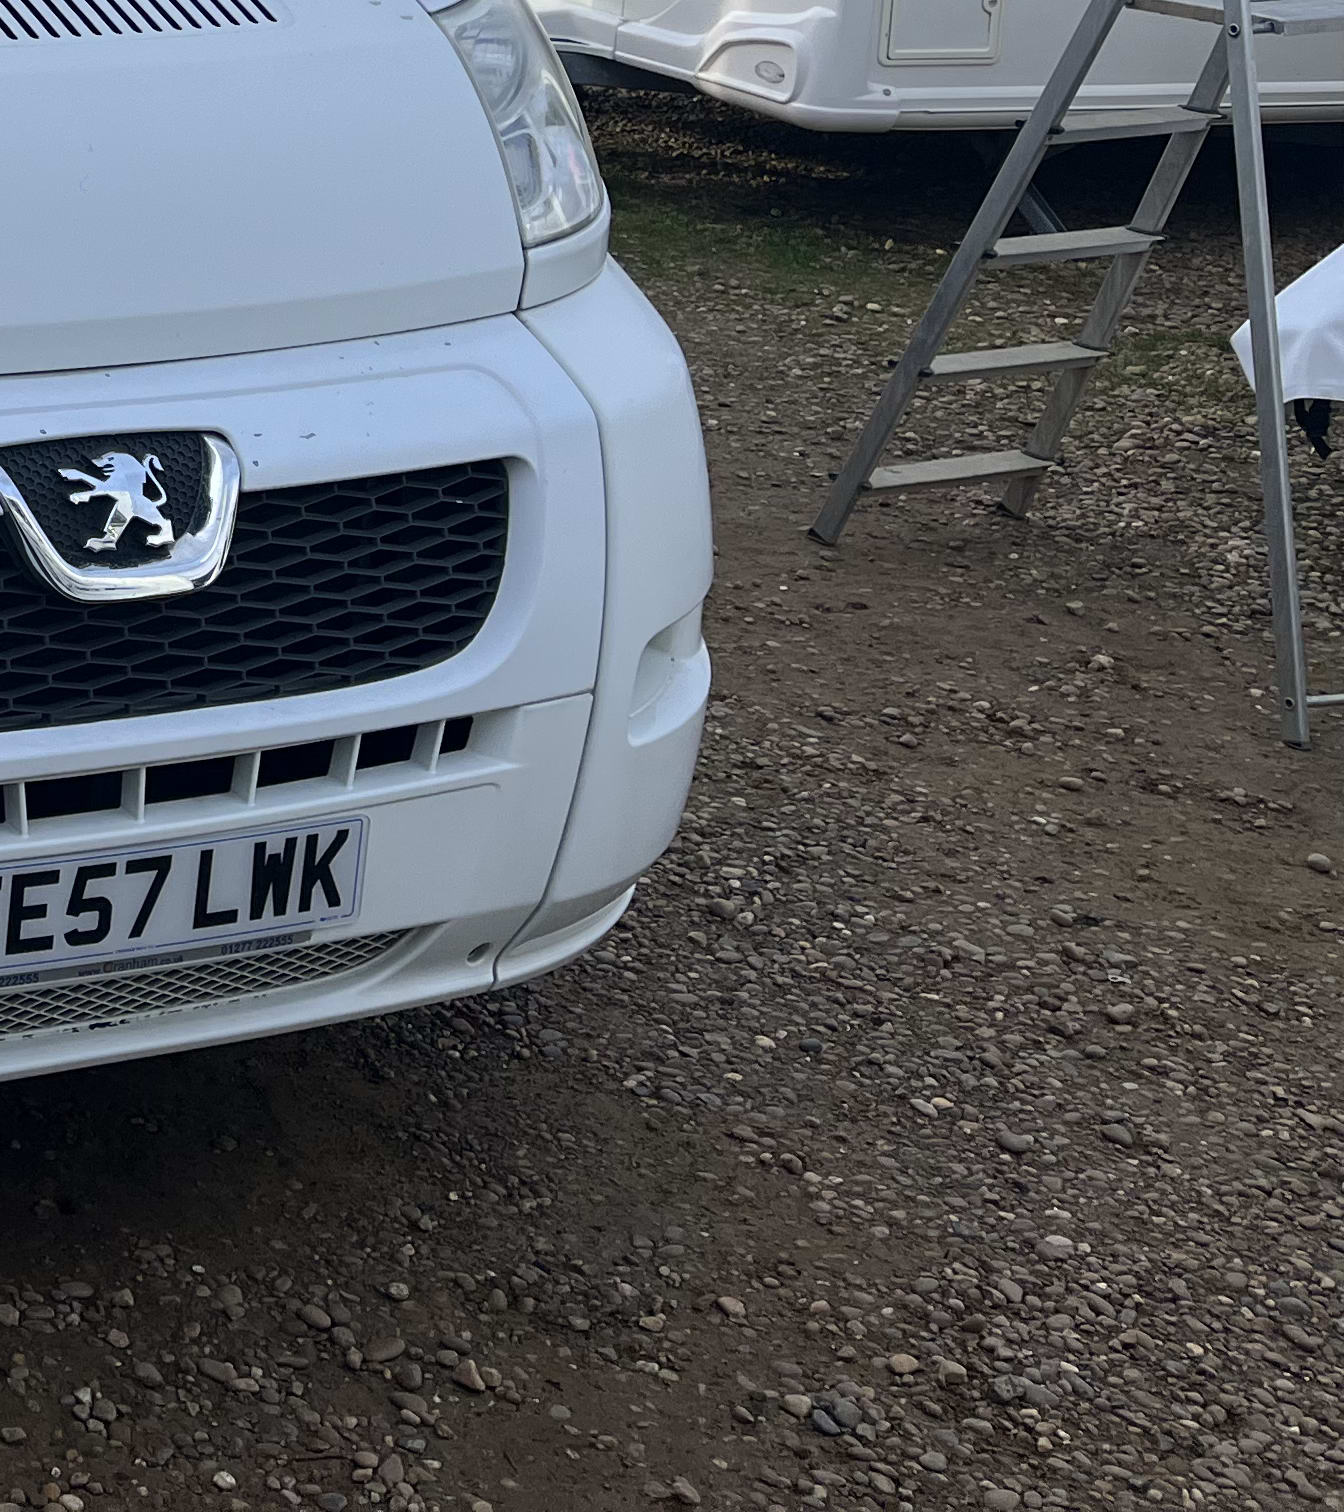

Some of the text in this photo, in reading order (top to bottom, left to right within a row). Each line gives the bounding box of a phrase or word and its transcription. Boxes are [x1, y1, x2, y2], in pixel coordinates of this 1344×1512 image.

[192, 828, 350, 931] LWK
[220, 939, 253, 955] 01277
[255, 934, 294, 951] 222555
